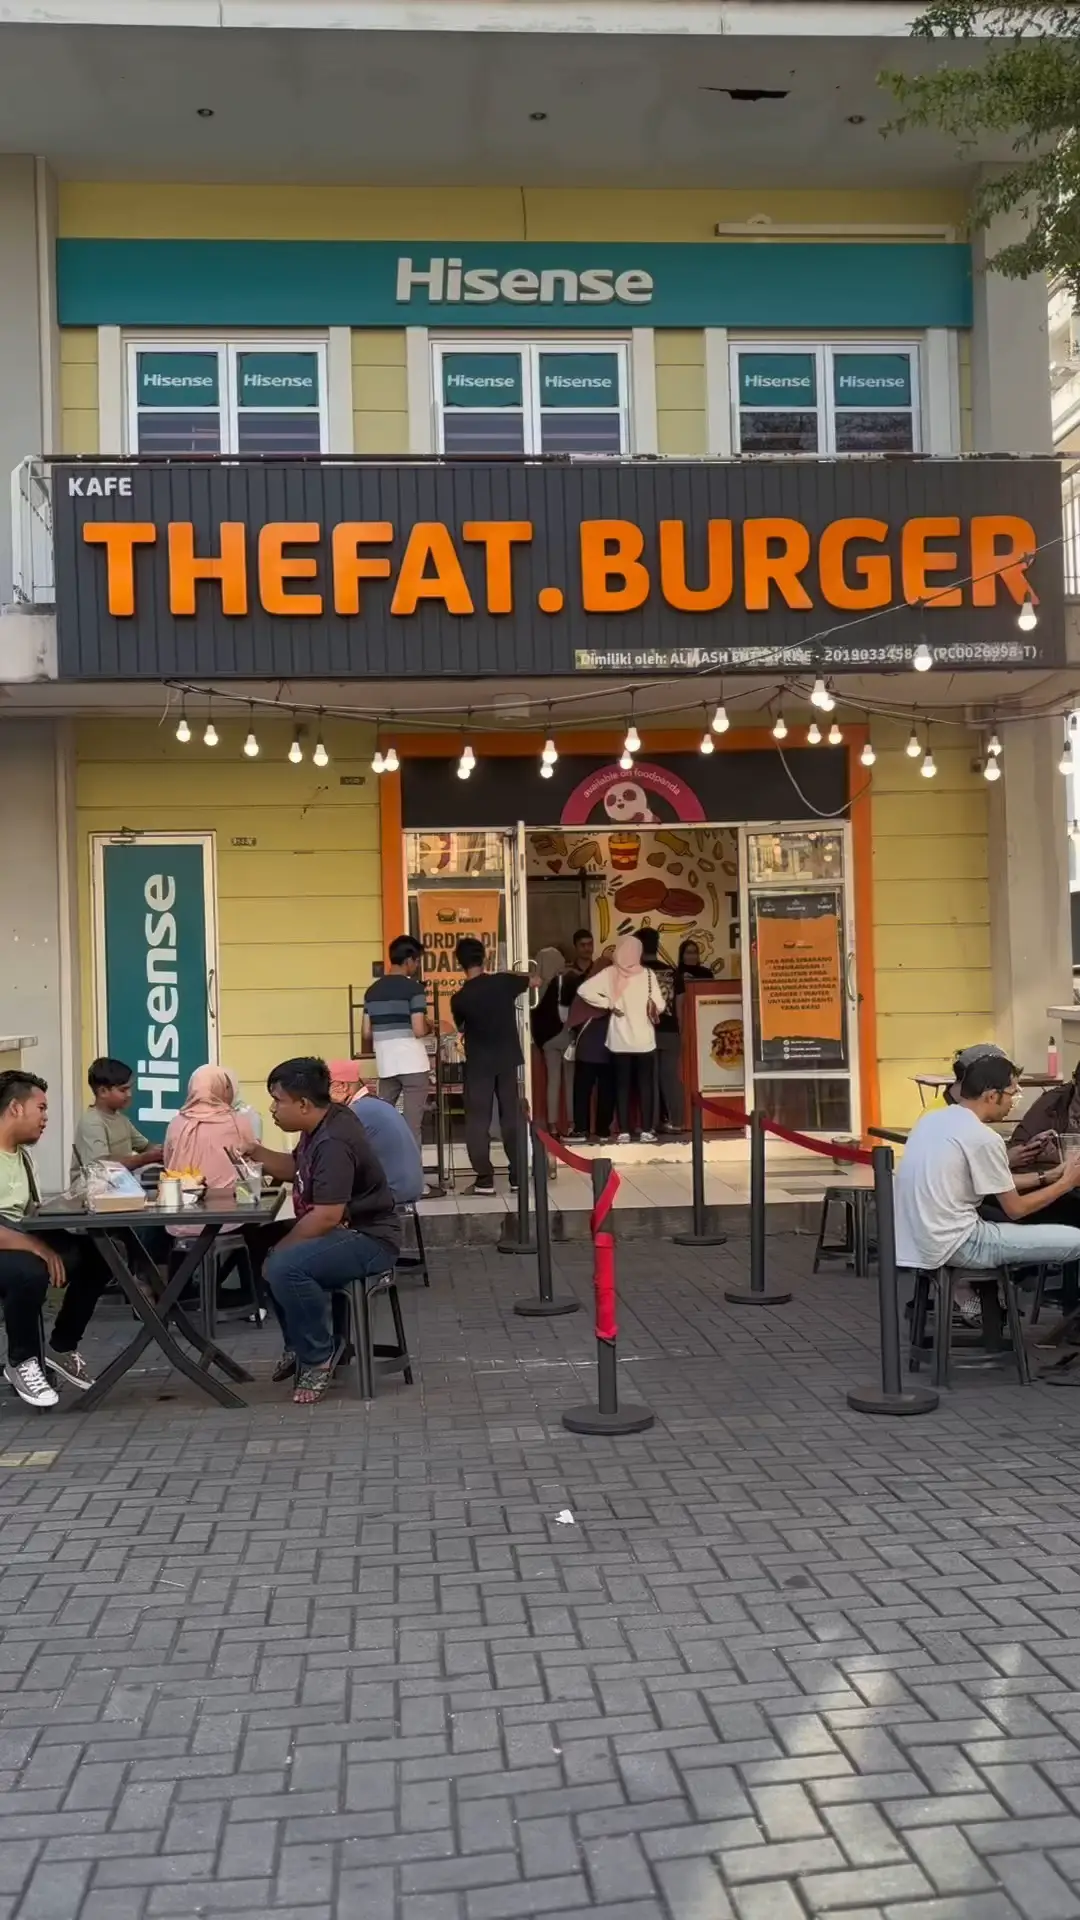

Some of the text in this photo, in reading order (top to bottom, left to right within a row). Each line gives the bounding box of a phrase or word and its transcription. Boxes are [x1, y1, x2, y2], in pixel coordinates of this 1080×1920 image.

[396, 257, 654, 304] Hisense
[143, 373, 213, 387] Hisense
[244, 373, 313, 387] Hisense
[447, 374, 515, 388] Hisense
[545, 375, 612, 388] Hisense
[744, 374, 811, 388] Hisense
[839, 375, 905, 388] Hisense
[68, 477, 132, 497] KAFE
[579, 650, 631, 665] Dimiliki
[635, 650, 667, 665] oleh:
[583, 768, 681, 798] available on foodpanda
[481, 932, 497, 948] DI
[137, 873, 180, 1122] Hisense
